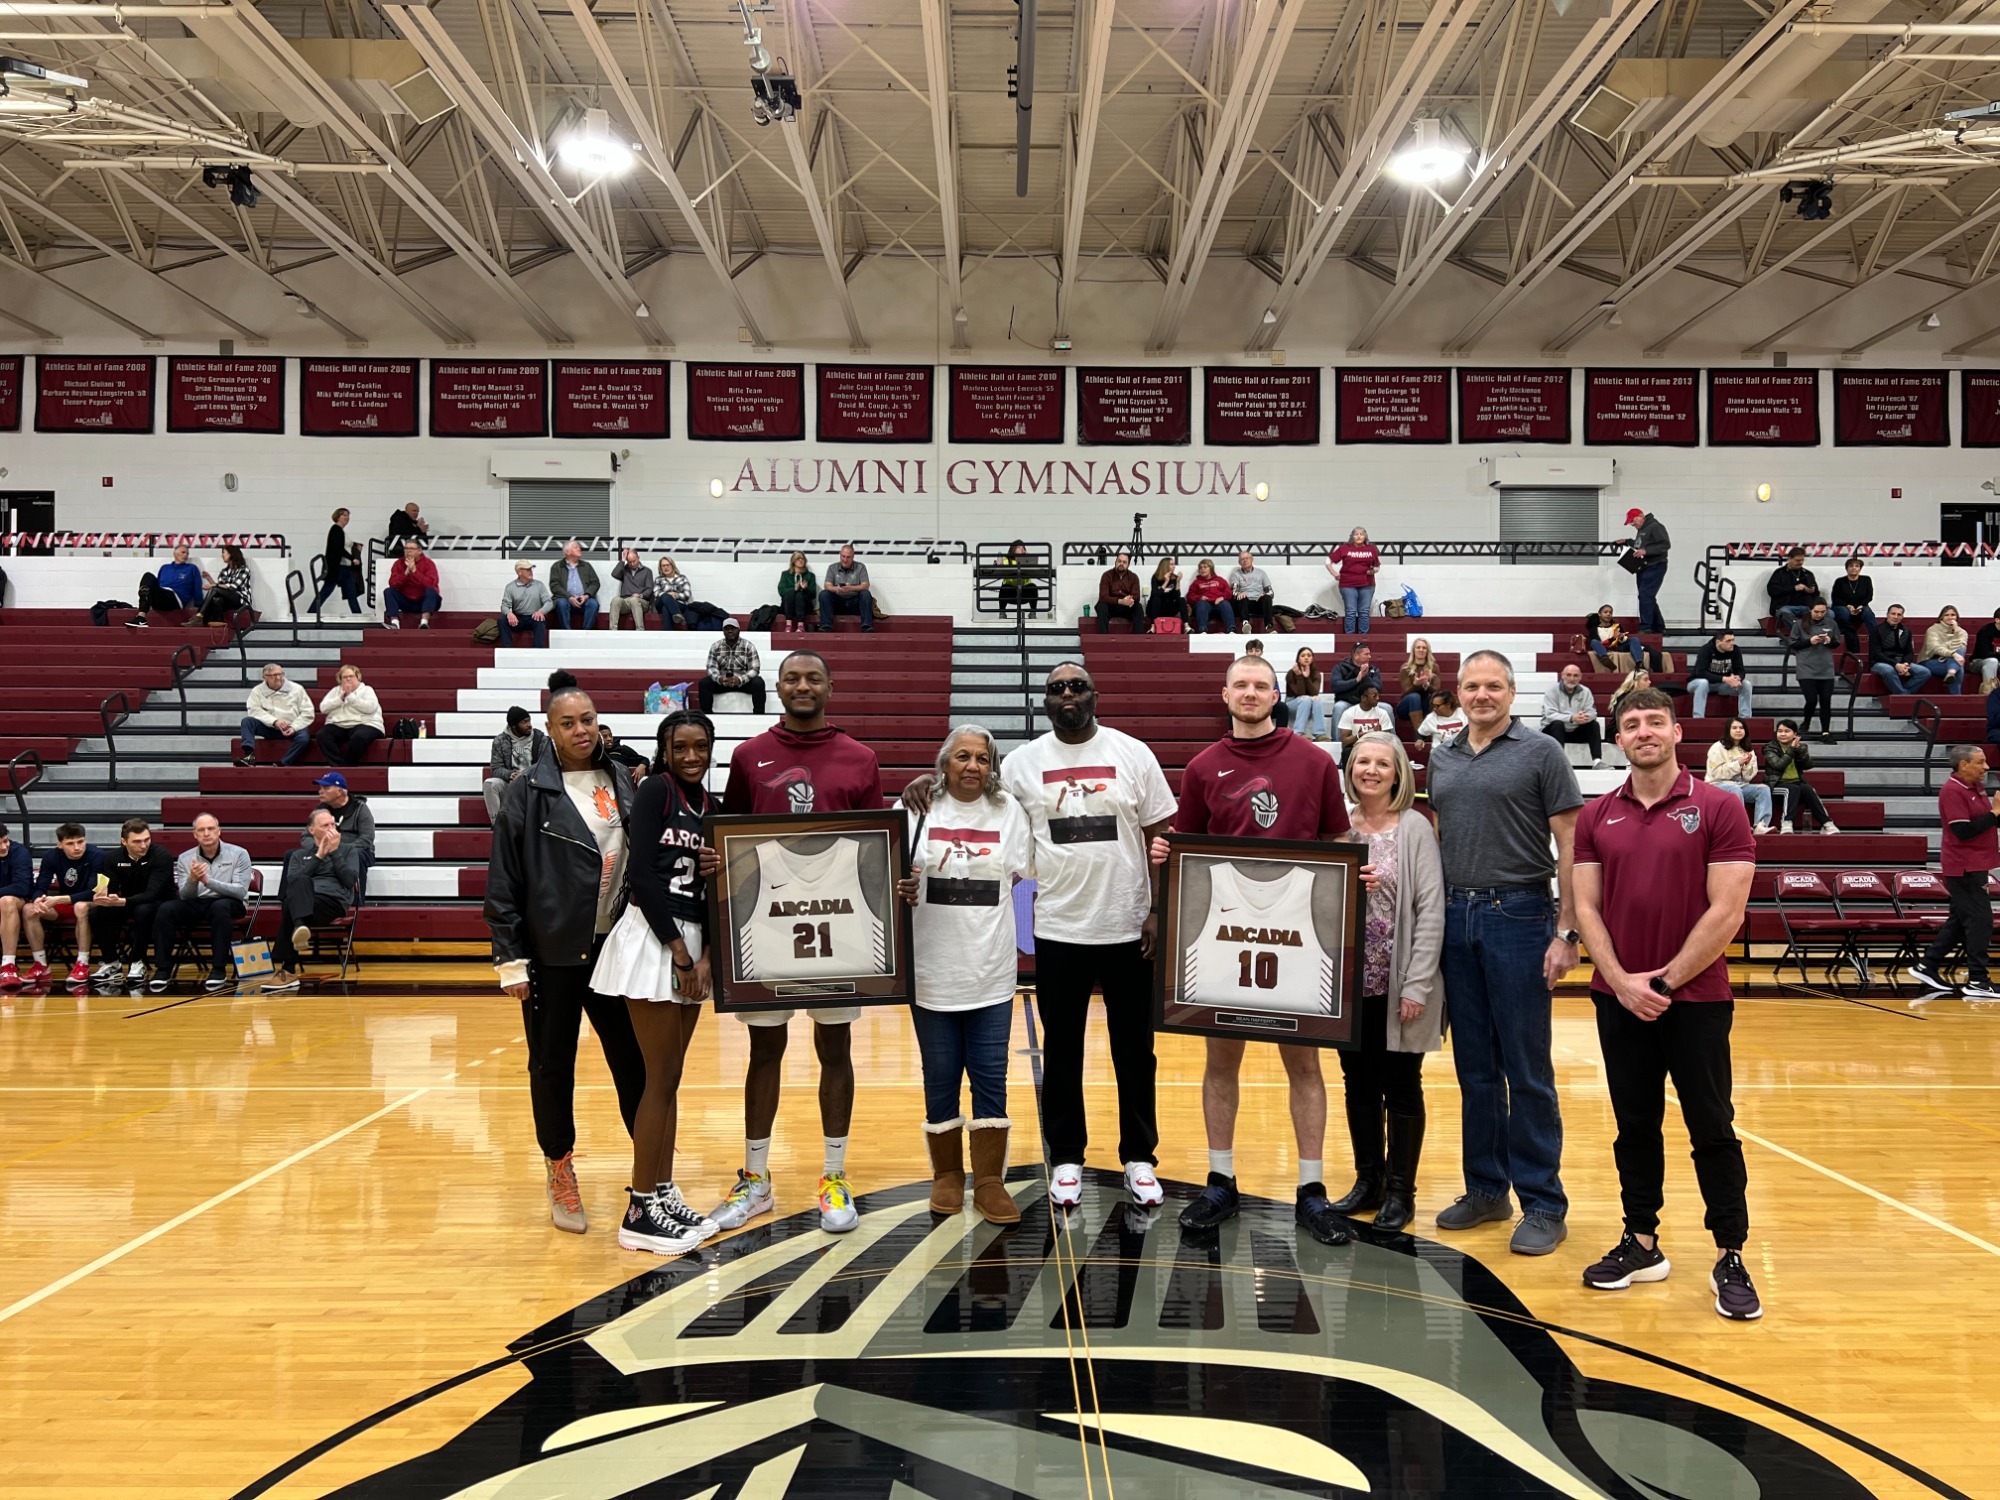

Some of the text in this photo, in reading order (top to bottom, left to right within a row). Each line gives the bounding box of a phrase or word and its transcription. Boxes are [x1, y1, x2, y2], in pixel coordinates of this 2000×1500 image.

[390, 365, 411, 373] 2009
[730, 458, 1250, 496] ALUMNI GYMNASIUM
[669, 856, 707, 900] 2
[769, 898, 854, 917] ARCADIA
[793, 922, 833, 959] 21
[1216, 925, 1303, 947] ARCADIA
[1238, 950, 1278, 989] 10
